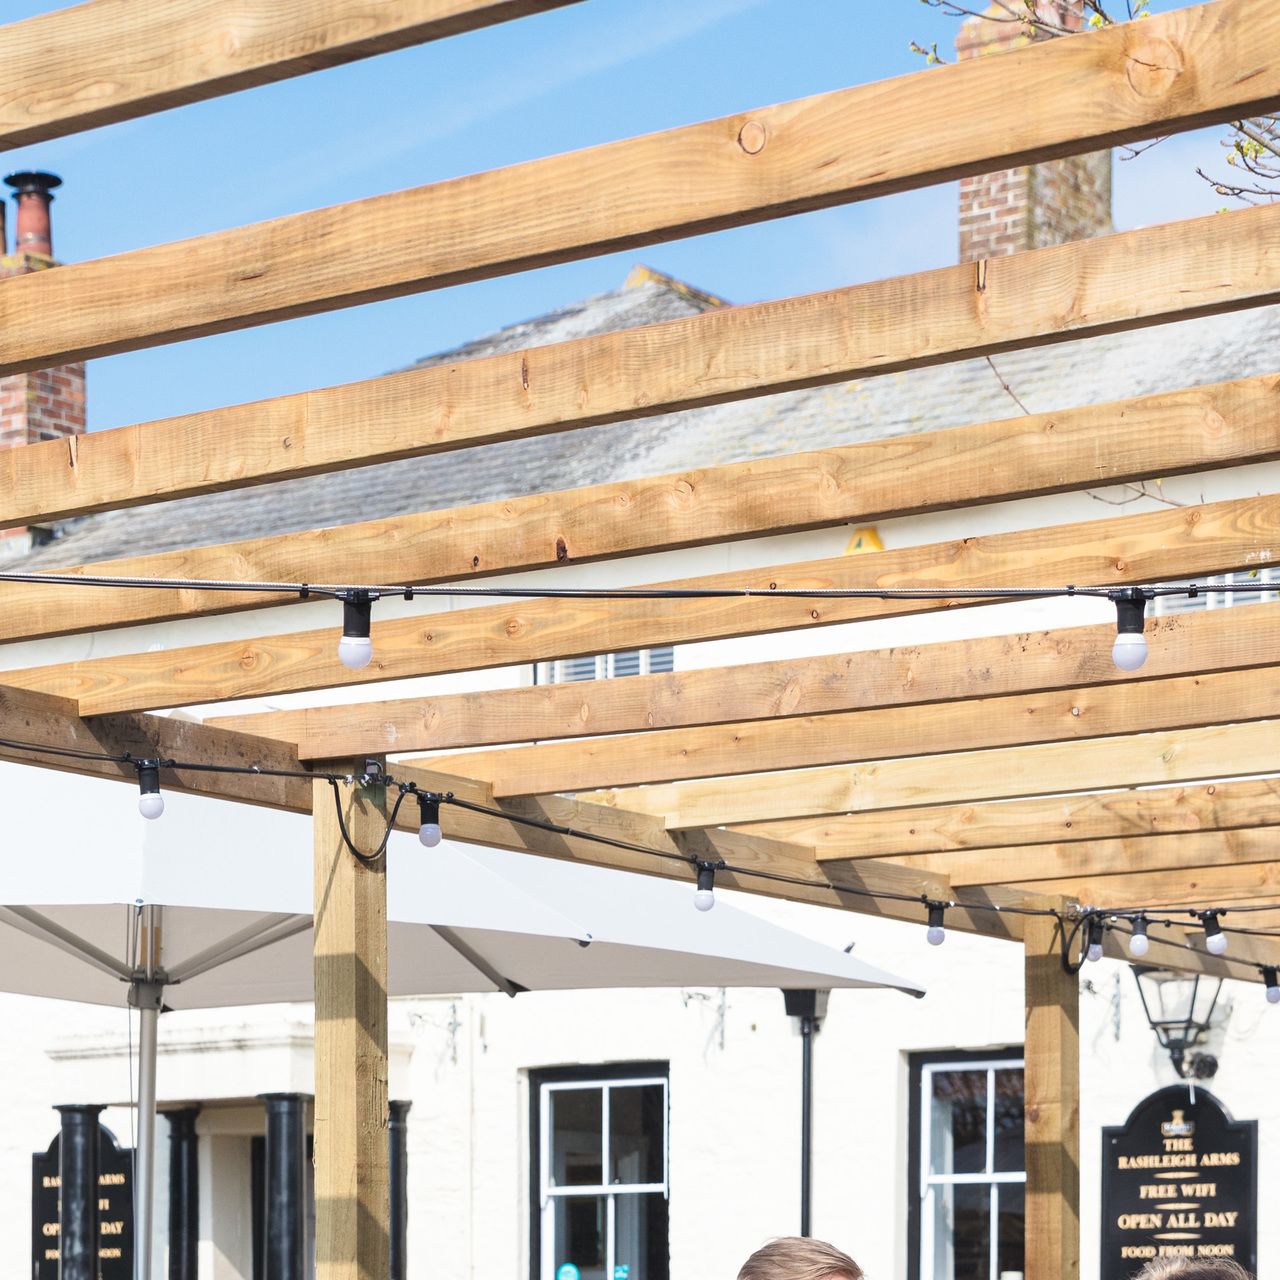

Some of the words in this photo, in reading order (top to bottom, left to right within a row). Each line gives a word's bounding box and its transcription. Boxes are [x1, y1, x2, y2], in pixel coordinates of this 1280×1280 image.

[1163, 1138, 1194, 1151] THE
[1118, 1154, 1197, 1169] RASHLEIGH
[1200, 1152, 1241, 1166] ARMS
[98, 1173, 126, 1185] ARMS
[1140, 1184, 1178, 1199] FREE
[1181, 1183, 1217, 1197] WIFI
[1117, 1213, 1163, 1229] OPEN
[1166, 1213, 1201, 1228] ALL
[1204, 1212, 1238, 1227] DAY
[100, 1221, 124, 1235] DAY
[1121, 1246, 1157, 1258] FOOD
[1198, 1244, 1234, 1256] NOON
